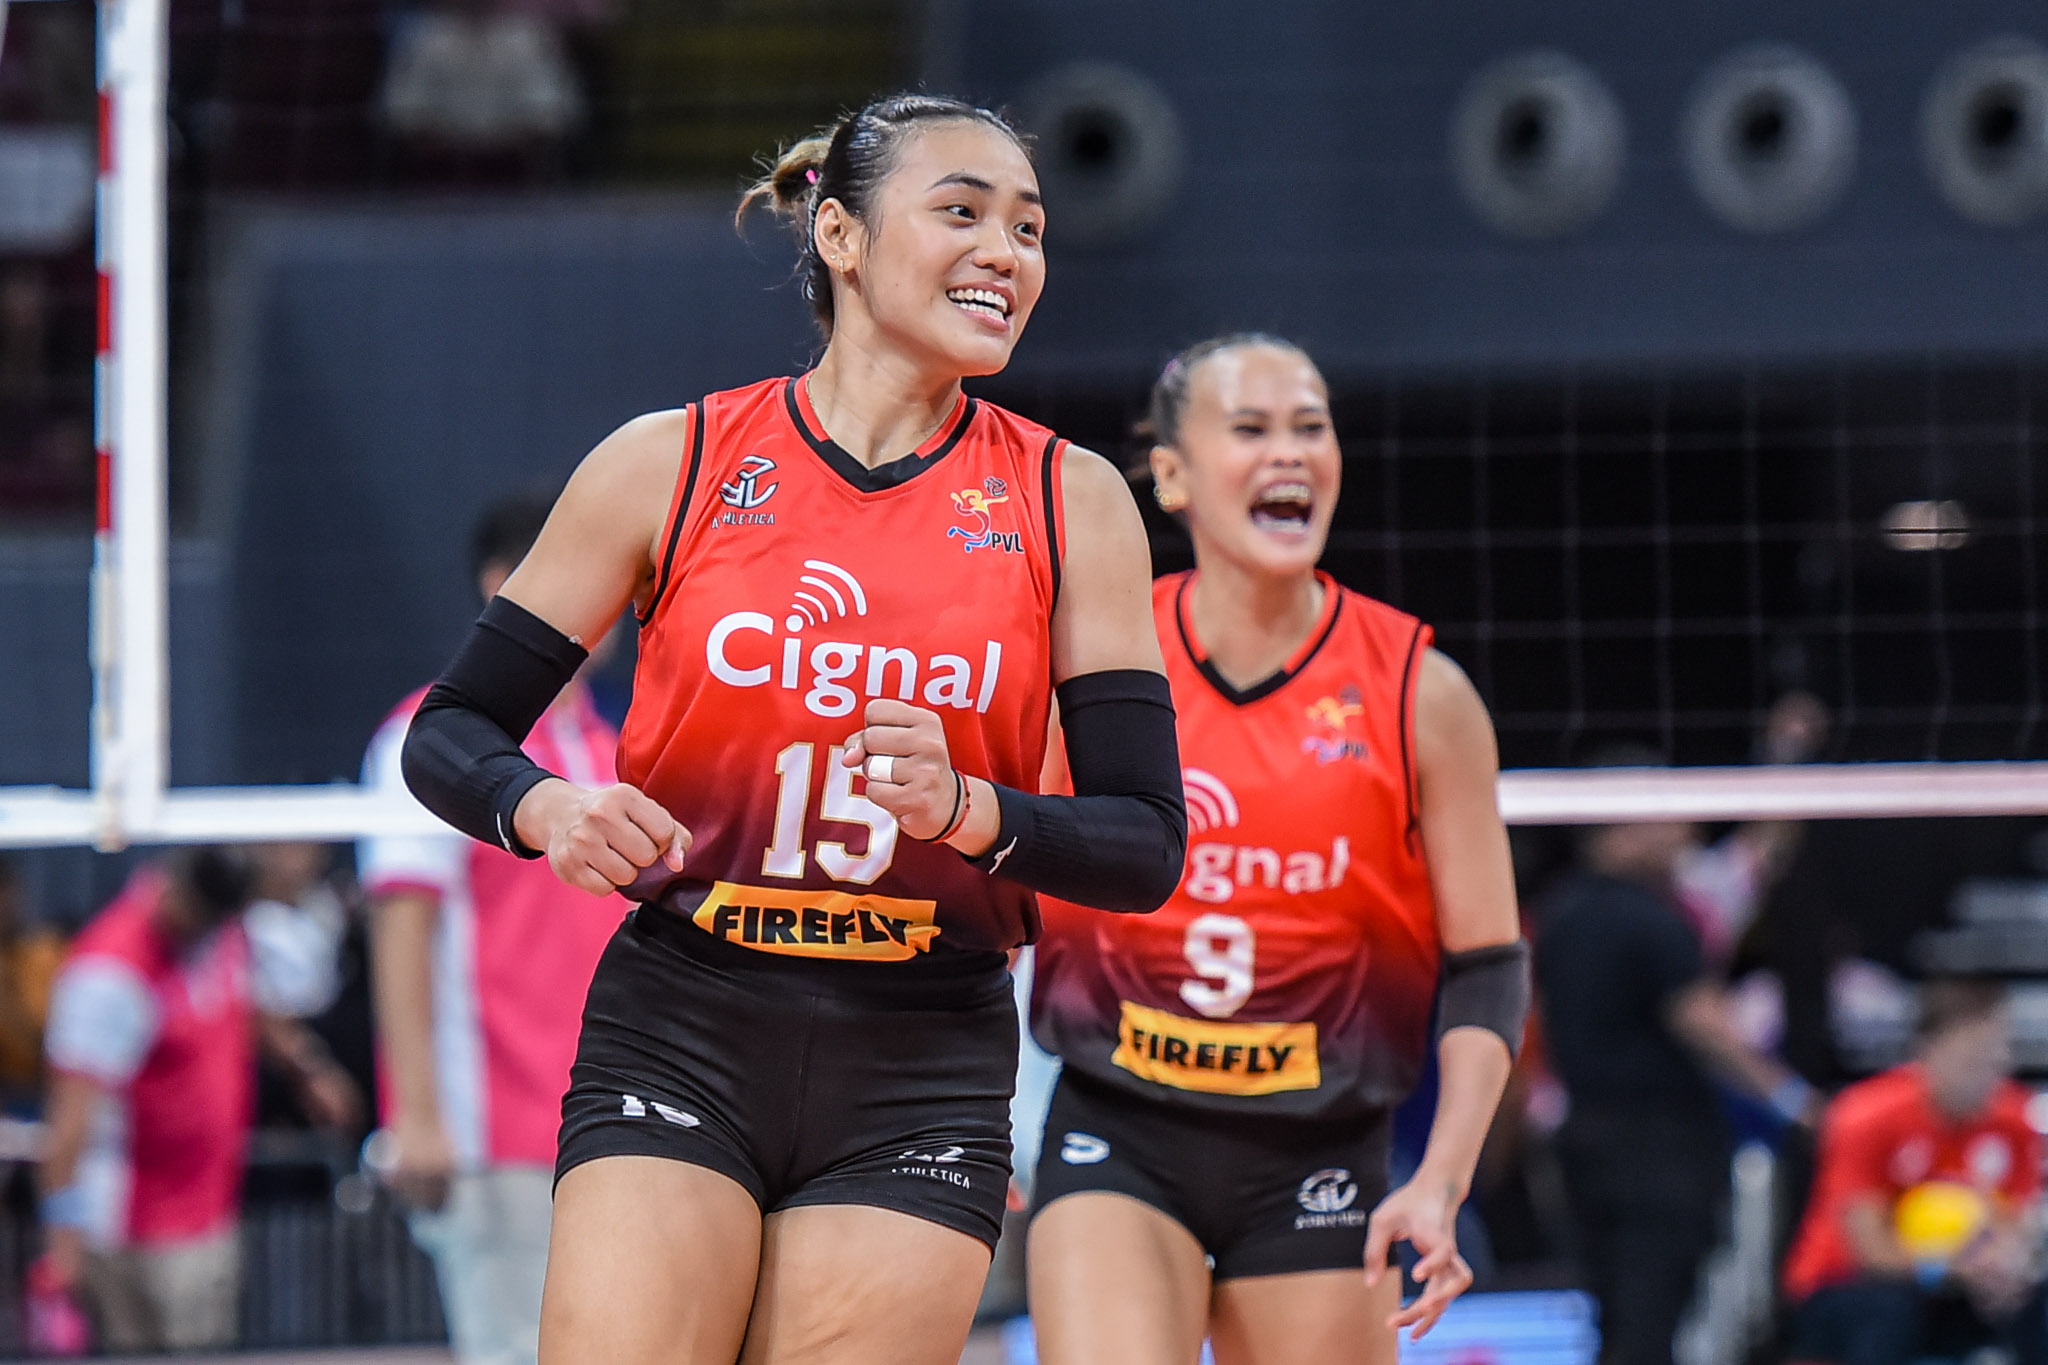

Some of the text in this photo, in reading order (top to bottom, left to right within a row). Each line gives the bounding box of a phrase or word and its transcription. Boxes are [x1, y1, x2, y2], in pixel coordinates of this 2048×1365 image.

[711, 511, 775, 529] AHLETICA
[991, 531, 1025, 554] PVL
[706, 611, 1001, 717] Cignal
[761, 741, 899, 885] 15
[1185, 835, 1350, 903] gnal
[713, 904, 912, 946] FIREFLY
[1179, 913, 1256, 1018] 9
[1133, 1029, 1293, 1073] FIREFLY
